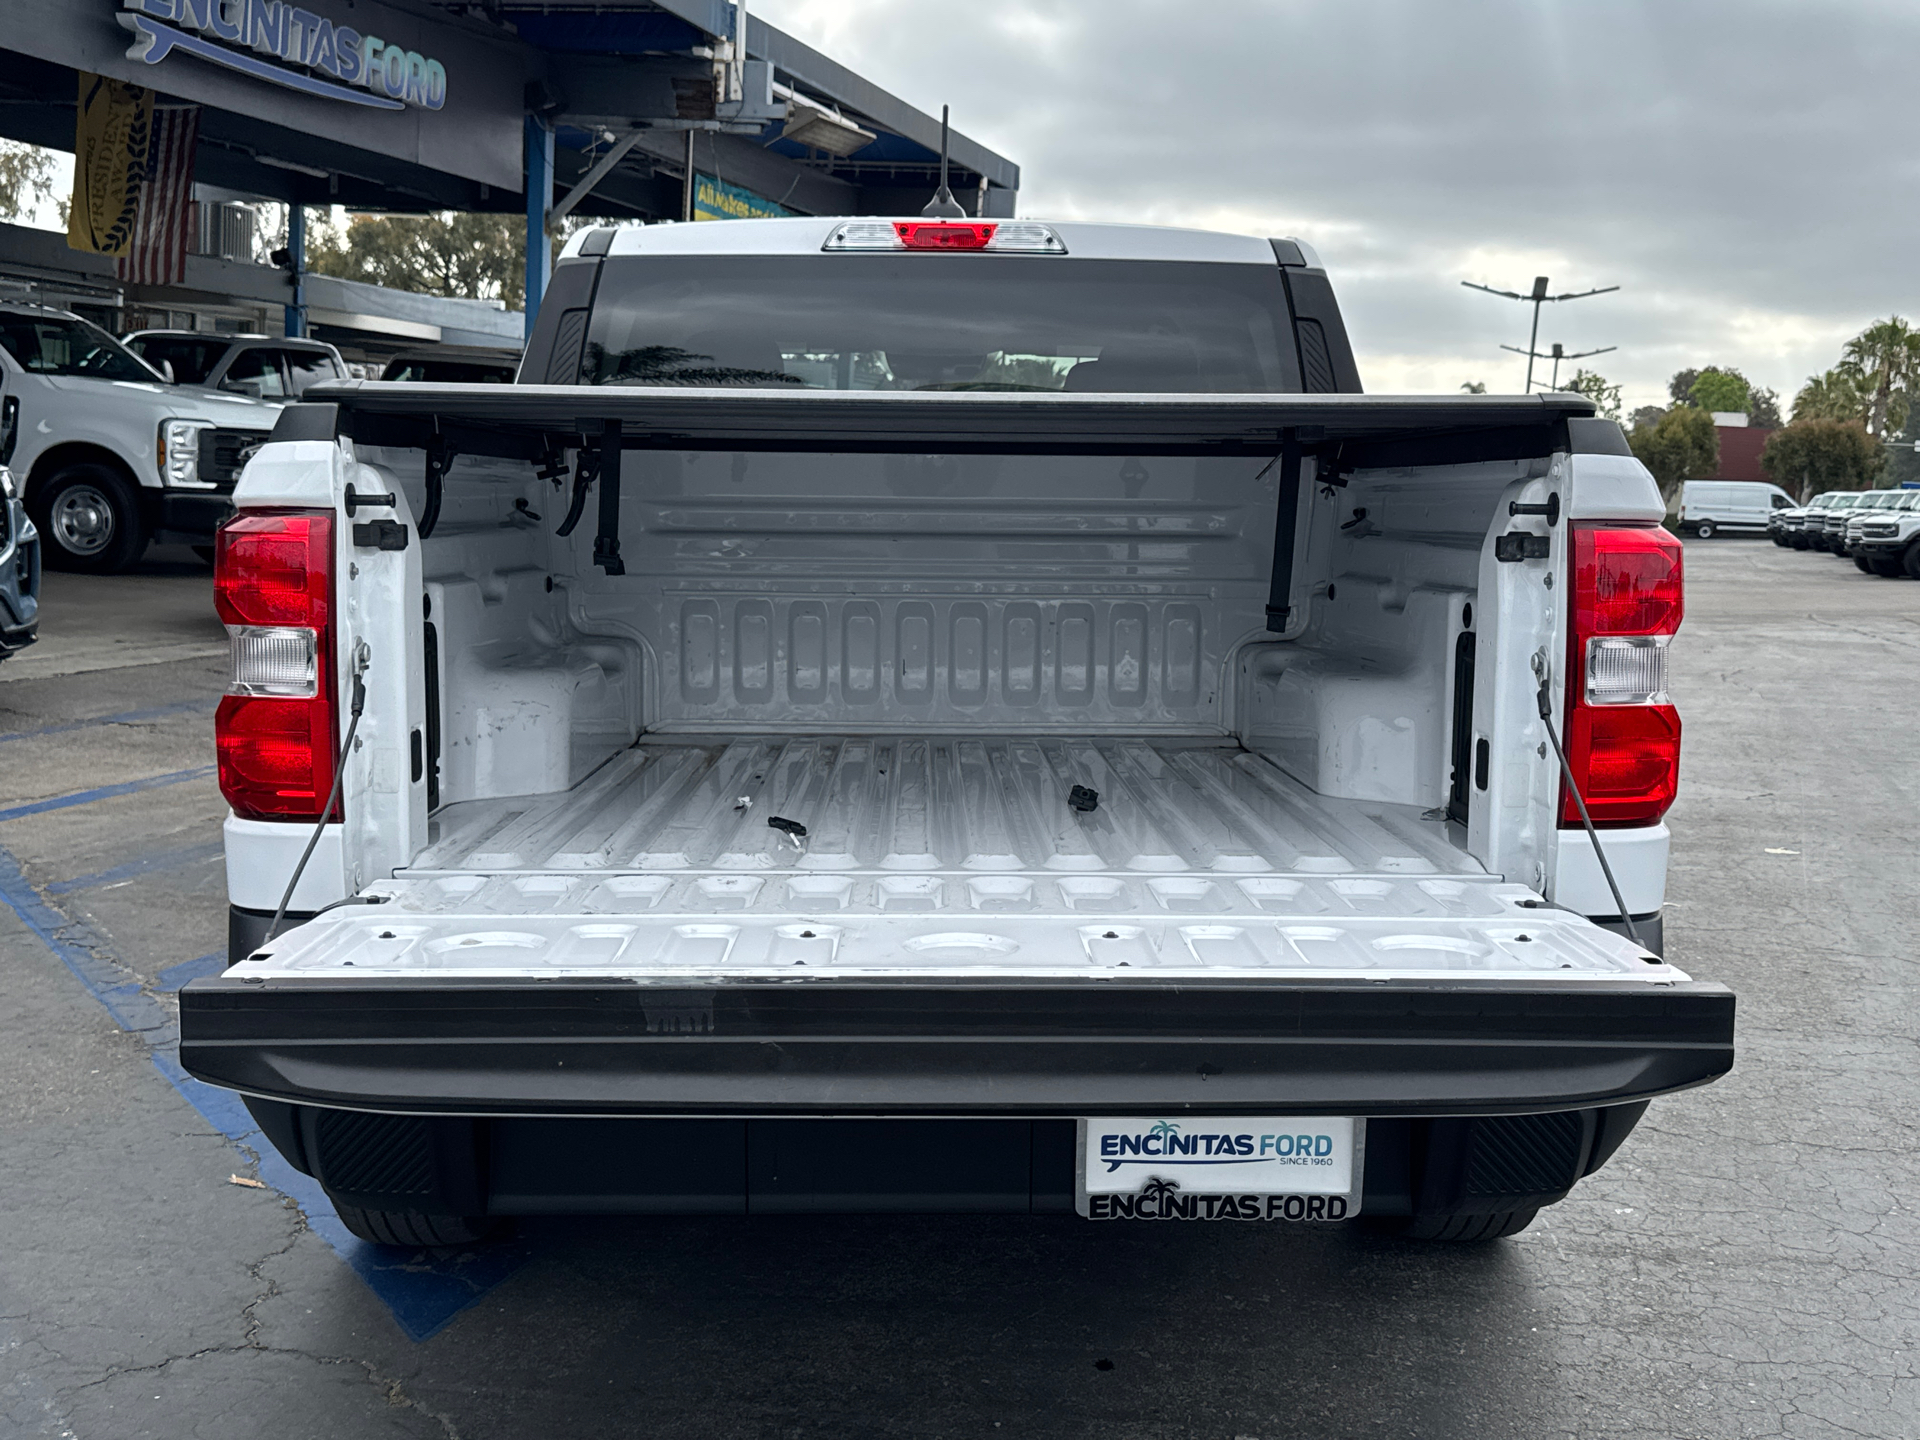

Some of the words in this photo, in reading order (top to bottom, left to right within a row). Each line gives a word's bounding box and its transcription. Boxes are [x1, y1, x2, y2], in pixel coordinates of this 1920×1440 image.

[364, 35, 448, 111] FORD
[1100, 1132, 1255, 1156] ENCINITAS
[1260, 1134, 1333, 1157] FORD
[1279, 1157, 1309, 1166] SINCE
[1310, 1157, 1333, 1167] 1960
[1089, 1193, 1261, 1220] ENCINITAS
[1266, 1194, 1348, 1220] FORD
